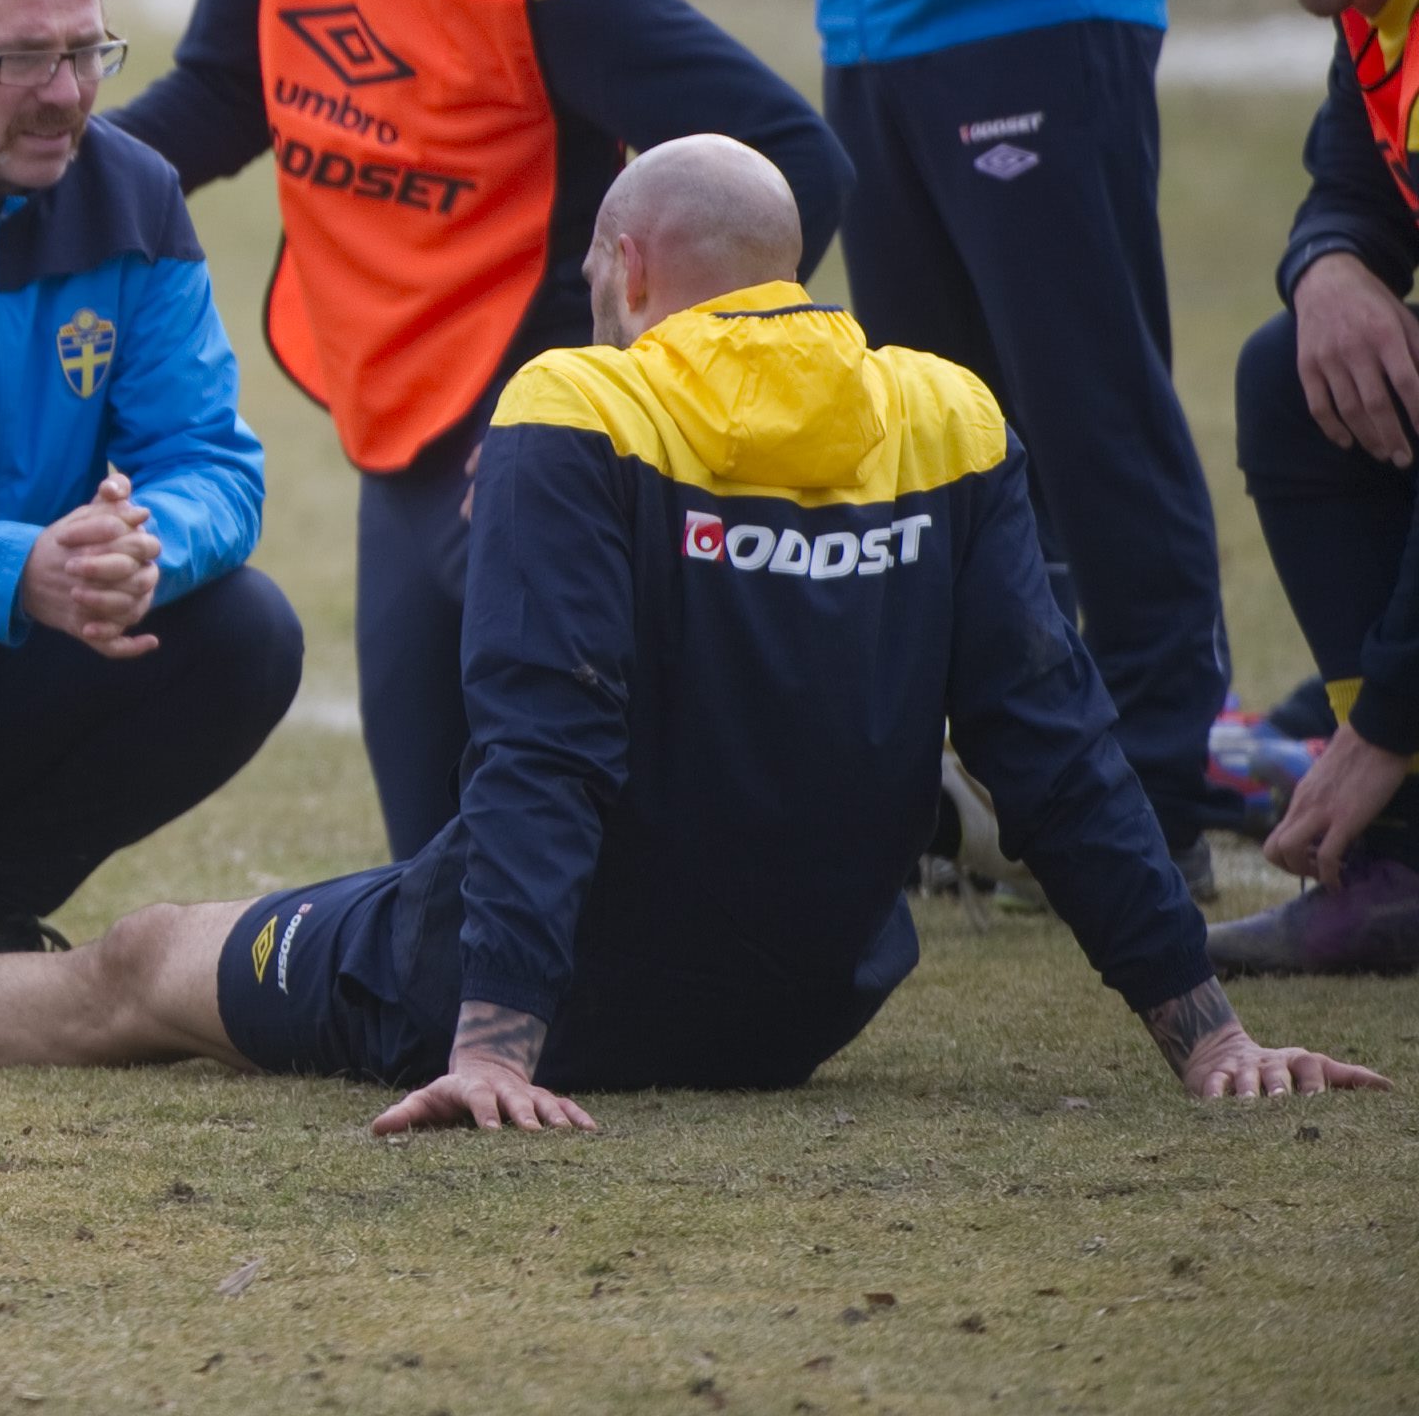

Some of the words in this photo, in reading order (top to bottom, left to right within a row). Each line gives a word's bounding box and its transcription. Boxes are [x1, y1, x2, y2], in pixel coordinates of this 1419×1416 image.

[273, 77, 399, 145] umbro
[270, 125, 477, 215] DDSET
[725, 514, 932, 580] ODDST
